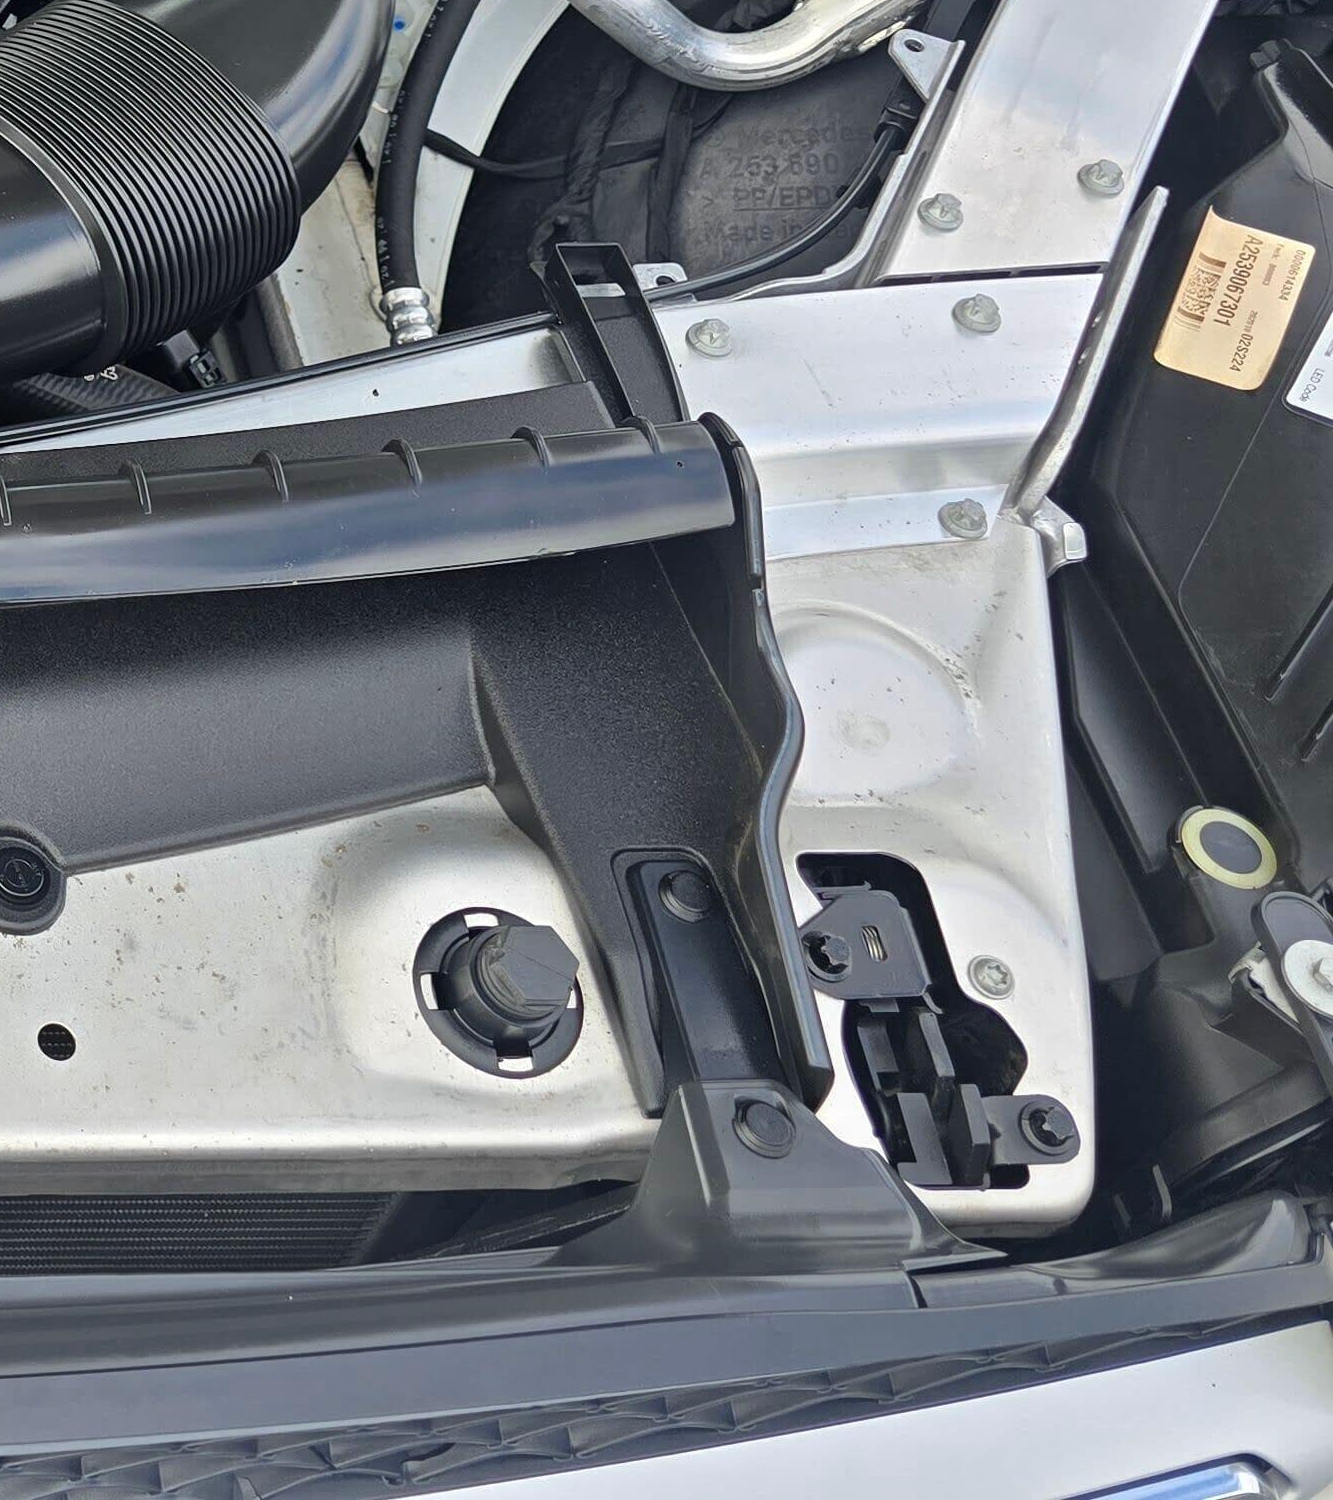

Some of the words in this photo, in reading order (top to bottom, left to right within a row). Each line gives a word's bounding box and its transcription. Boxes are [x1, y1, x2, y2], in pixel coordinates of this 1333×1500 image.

[733, 184, 837, 208] PP/EPD
[1213, 234, 1264, 327] A2539067301
[1229, 333, 1254, 373] 02S224
[1310, 367, 1325, 383] LED
